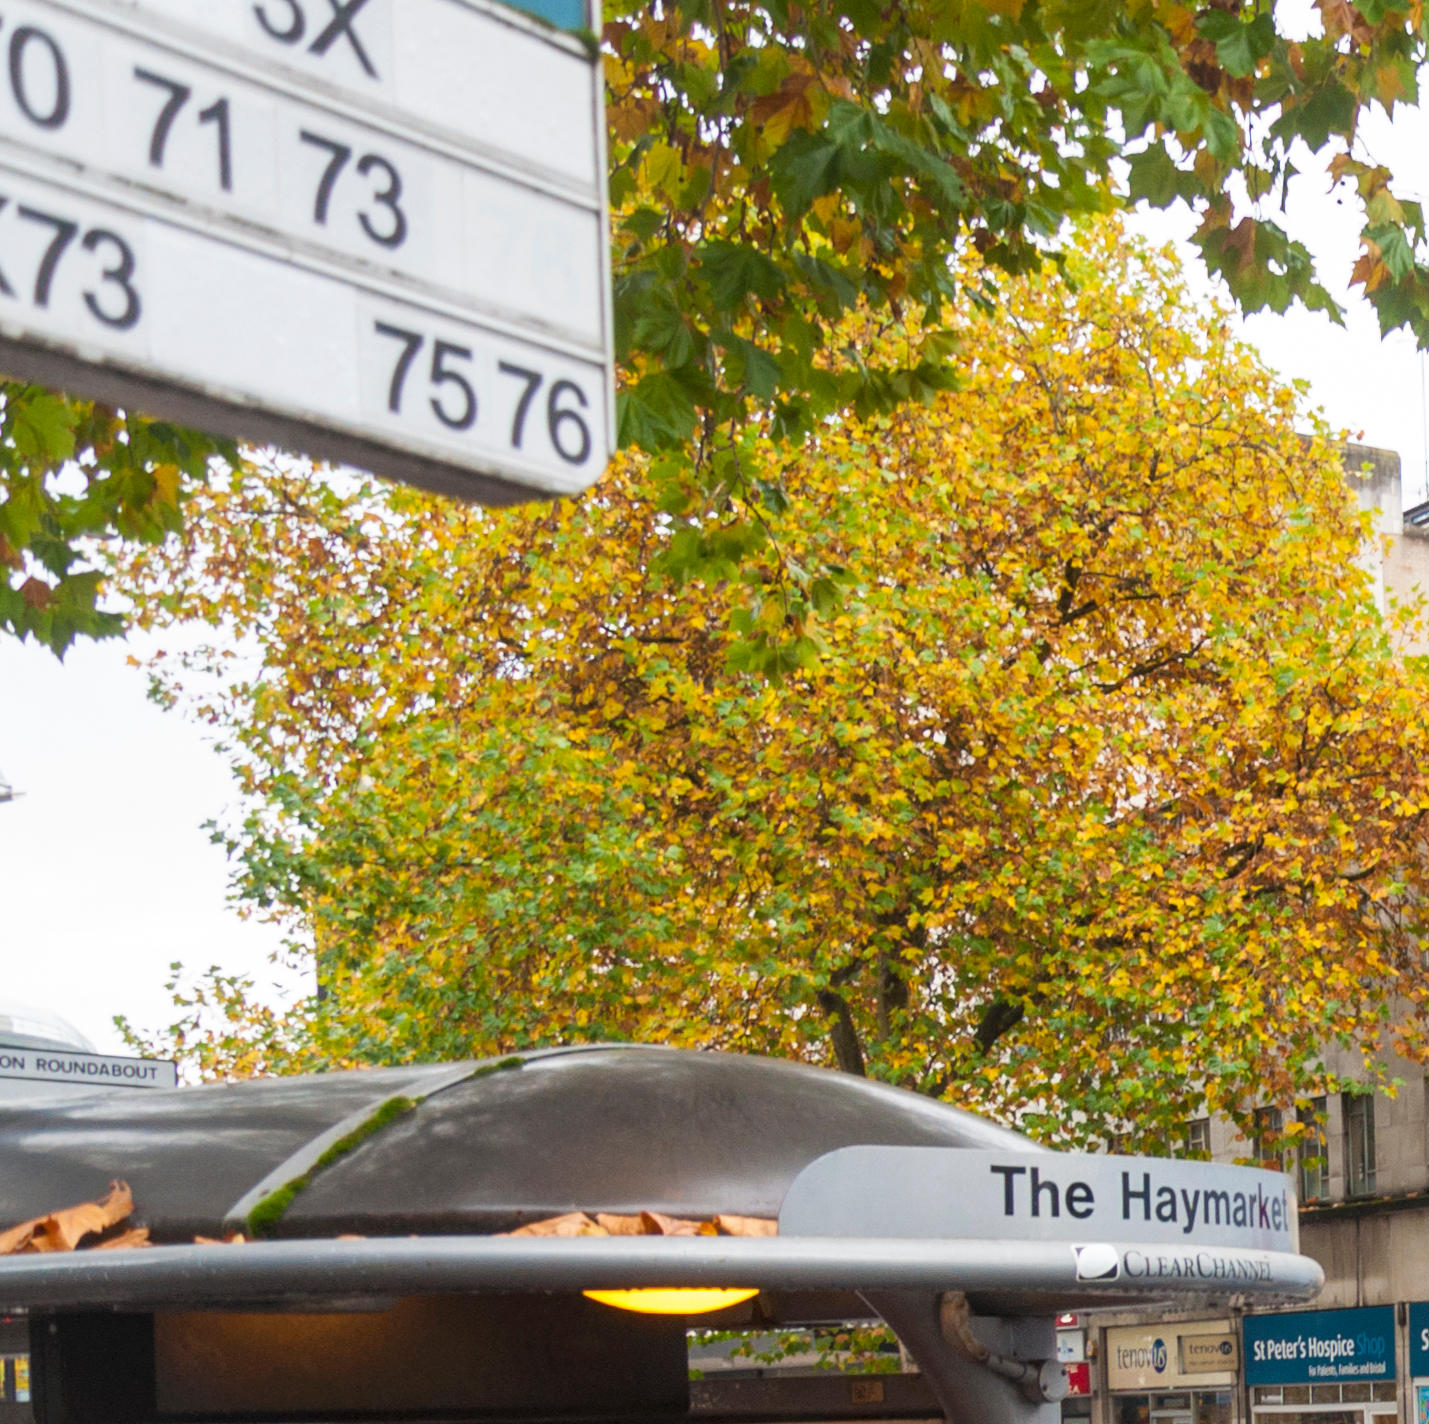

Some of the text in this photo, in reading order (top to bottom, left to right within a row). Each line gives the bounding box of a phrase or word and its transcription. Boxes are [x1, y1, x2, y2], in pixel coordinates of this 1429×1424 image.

[0, 16, 407, 249] 0 71 73
[0, 203, 142, 331] 73
[374, 320, 591, 465] 75 76
[36, 1058, 158, 1080] ROUNDABOUT
[990, 1165, 1289, 1234] The Haymarket
[1254, 1332, 1385, 1362] St Peter's Hospice Shop
